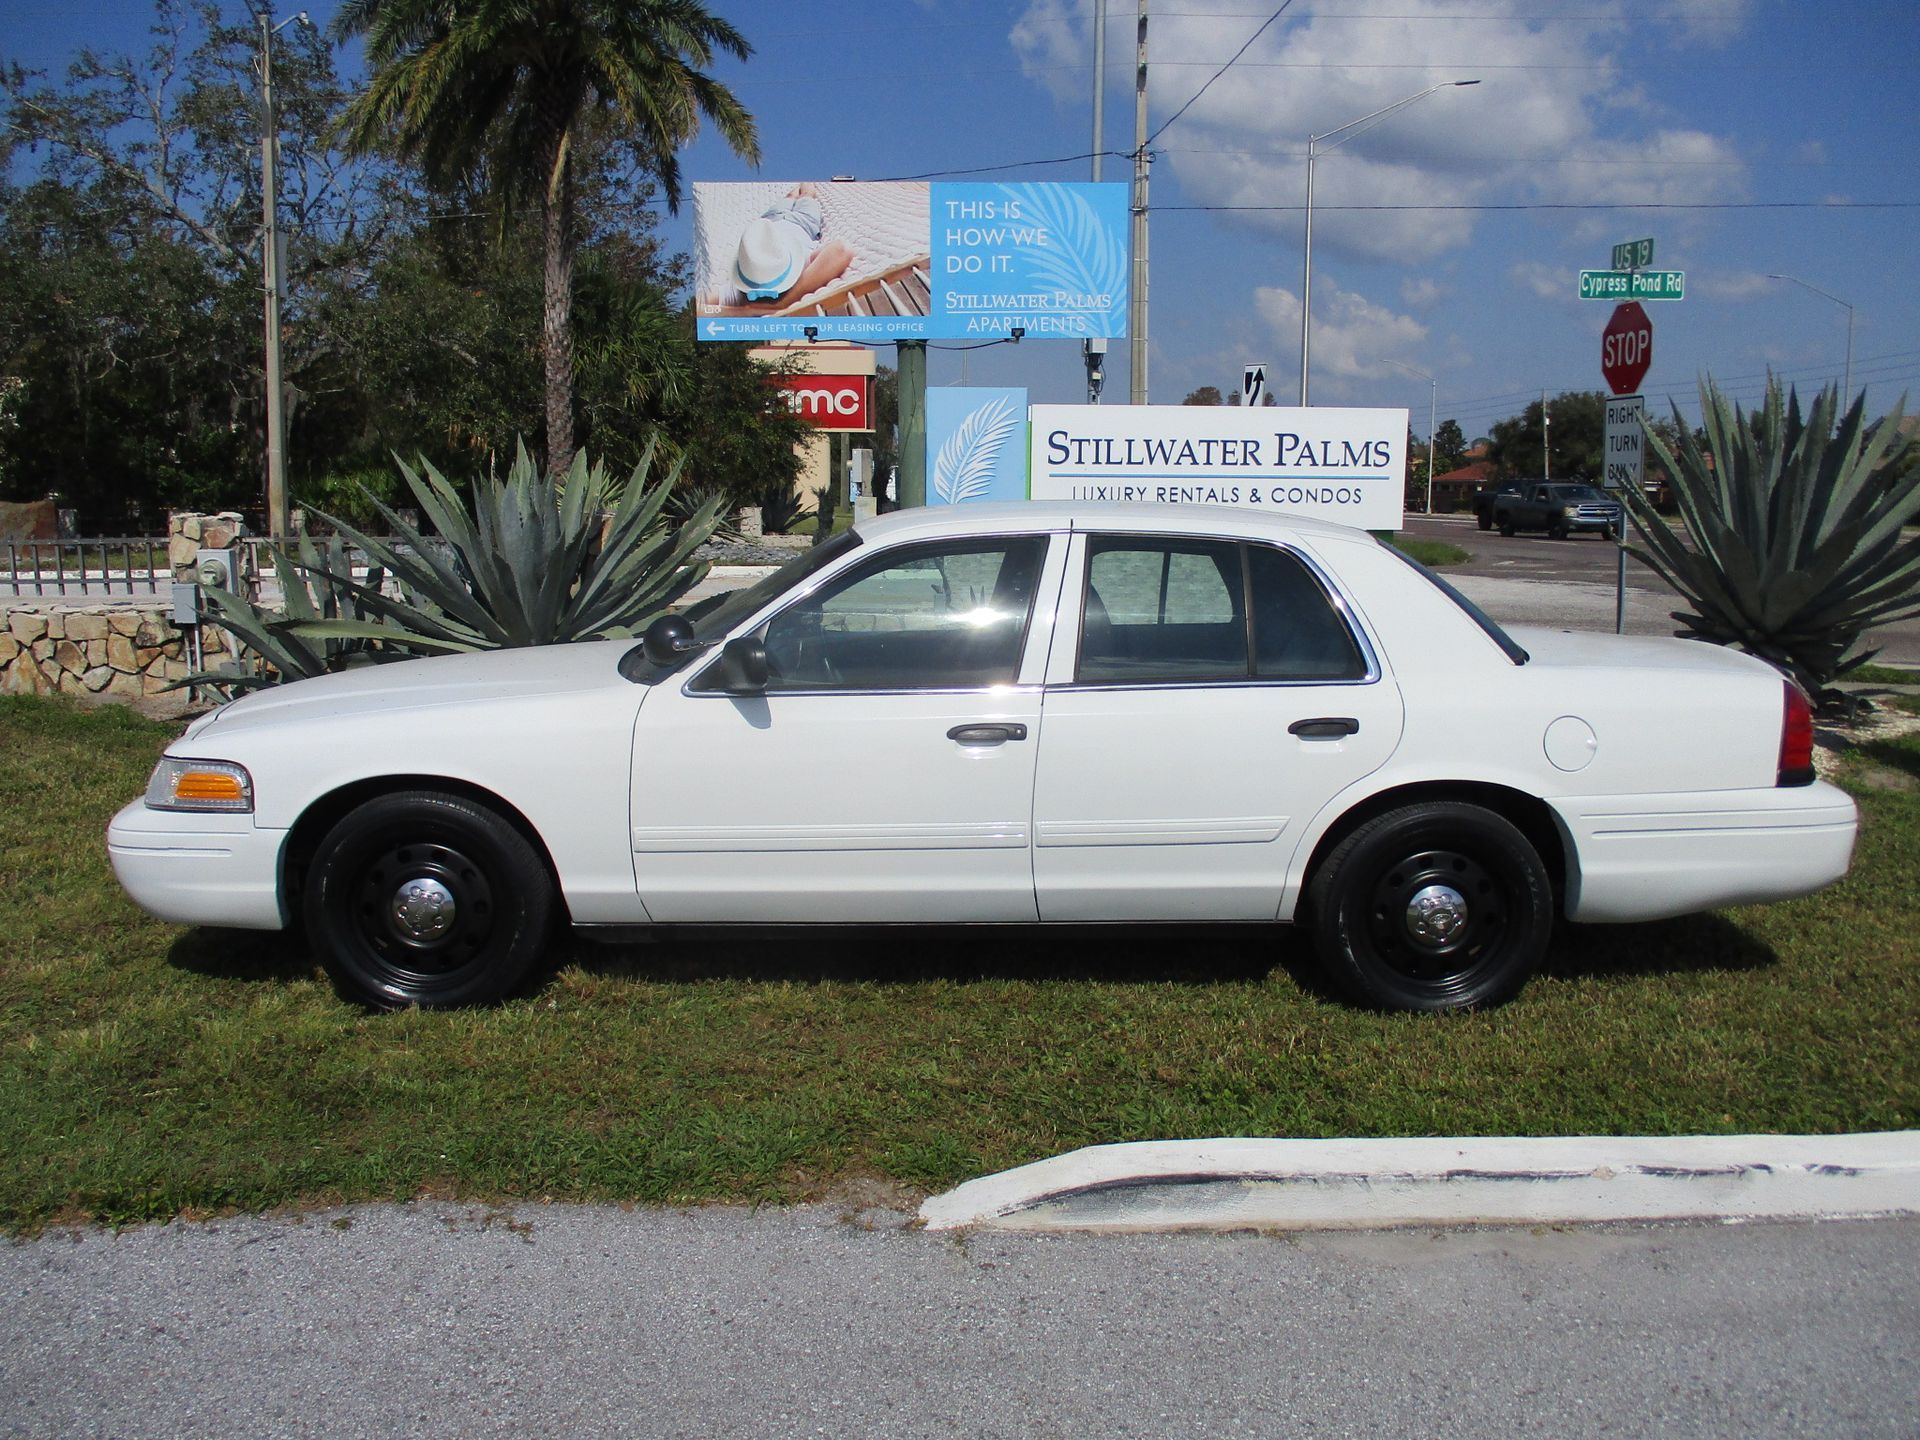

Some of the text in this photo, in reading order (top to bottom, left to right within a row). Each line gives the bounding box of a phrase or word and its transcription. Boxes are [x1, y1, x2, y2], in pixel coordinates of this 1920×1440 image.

[946, 201, 1021, 220] THIS IS
[946, 228, 1048, 247] HOW WE
[1615, 240, 1650, 269] US 19
[946, 255, 1015, 273] DO IT.
[1581, 273, 1682, 297] Cypress Pond Rd
[729, 324, 760, 333] TURN
[764, 324, 787, 333] LEFT
[791, 323, 805, 333] TO
[838, 323, 883, 332] LEASING
[887, 322, 924, 332] OFFICE
[966, 316, 1087, 333] APARTMENTS
[1605, 329, 1649, 368] STOP
[1608, 406, 1640, 424] RIGHT
[1610, 435, 1638, 452] TURN
[1608, 463, 1637, 479] ONY
[1072, 486, 1362, 504] LUXURY RENTALS & CONDOS
